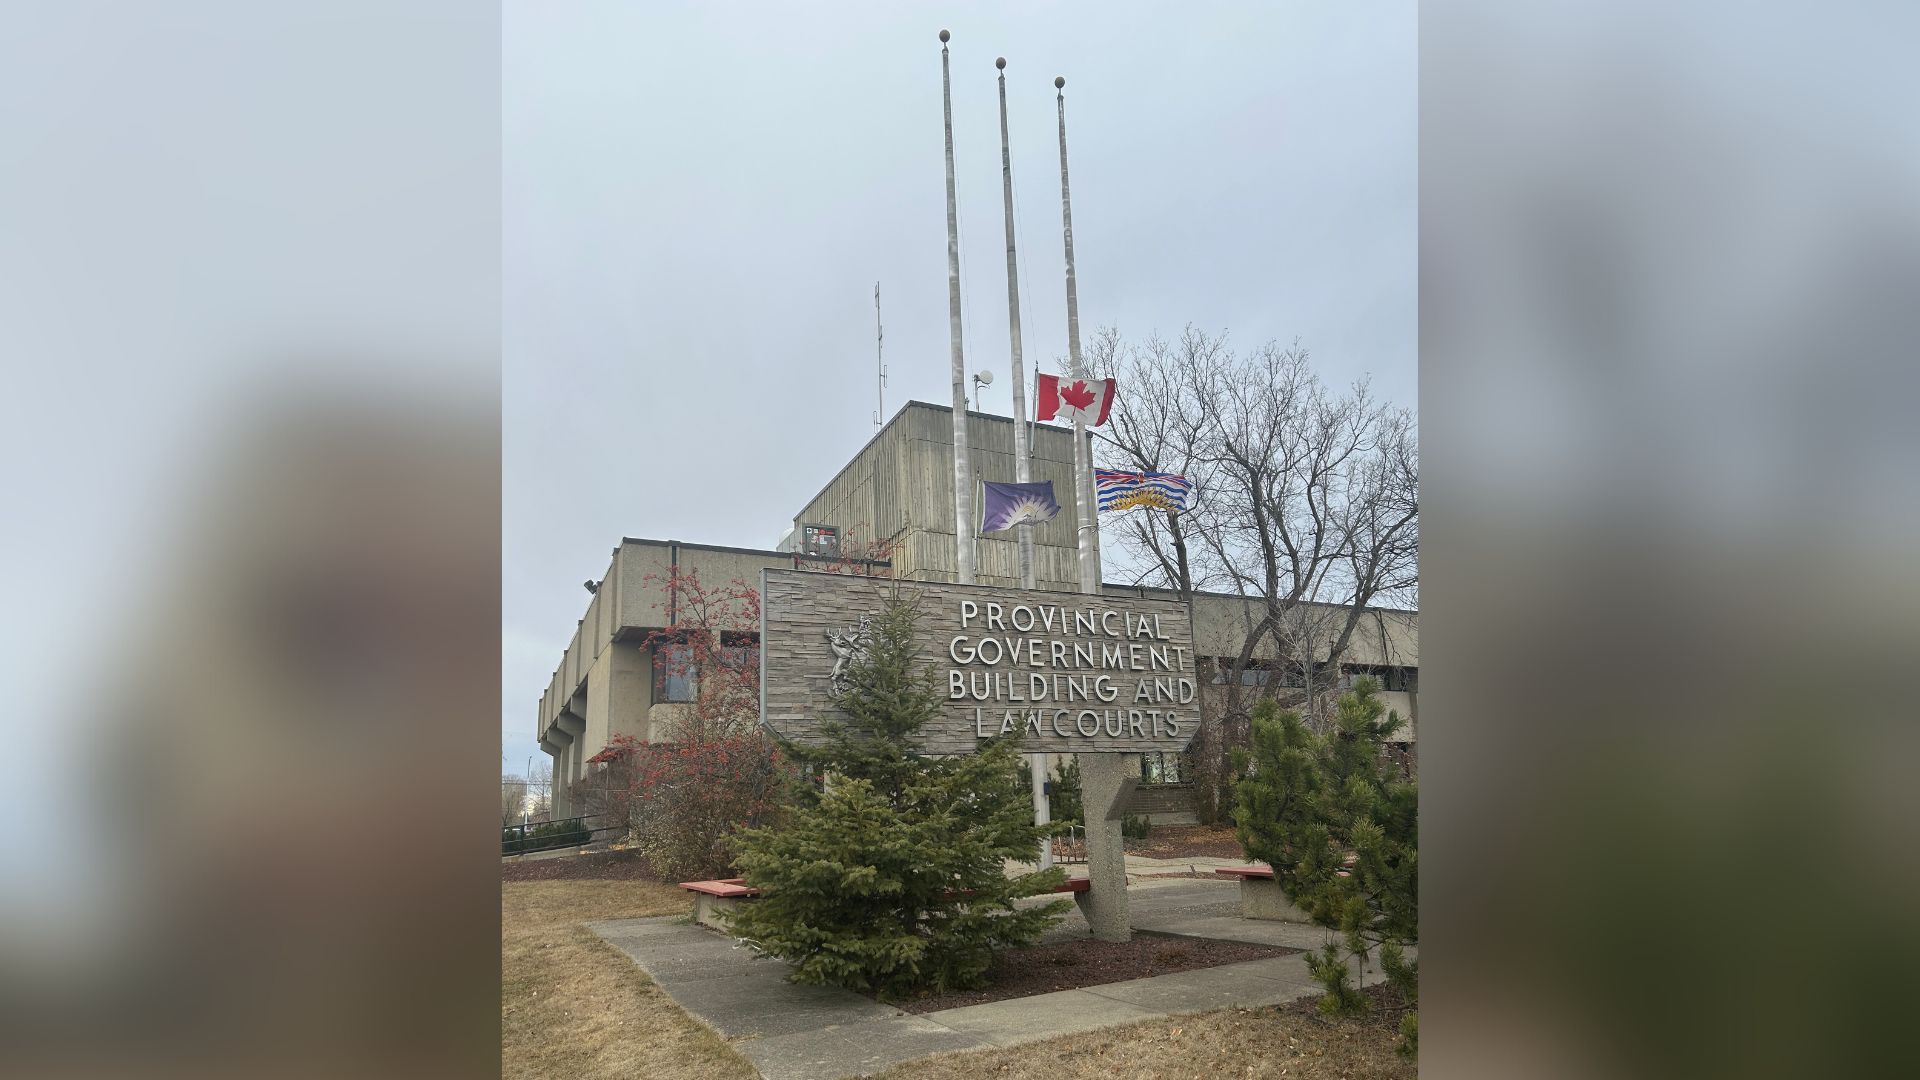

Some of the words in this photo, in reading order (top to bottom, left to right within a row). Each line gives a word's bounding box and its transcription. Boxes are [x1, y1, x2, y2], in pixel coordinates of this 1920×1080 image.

[961, 600, 1170, 640] PROVINCIAL
[950, 635, 1186, 671] GOVERNMENT
[950, 669, 1118, 702] BUILDING
[1134, 676, 1194, 704] AND
